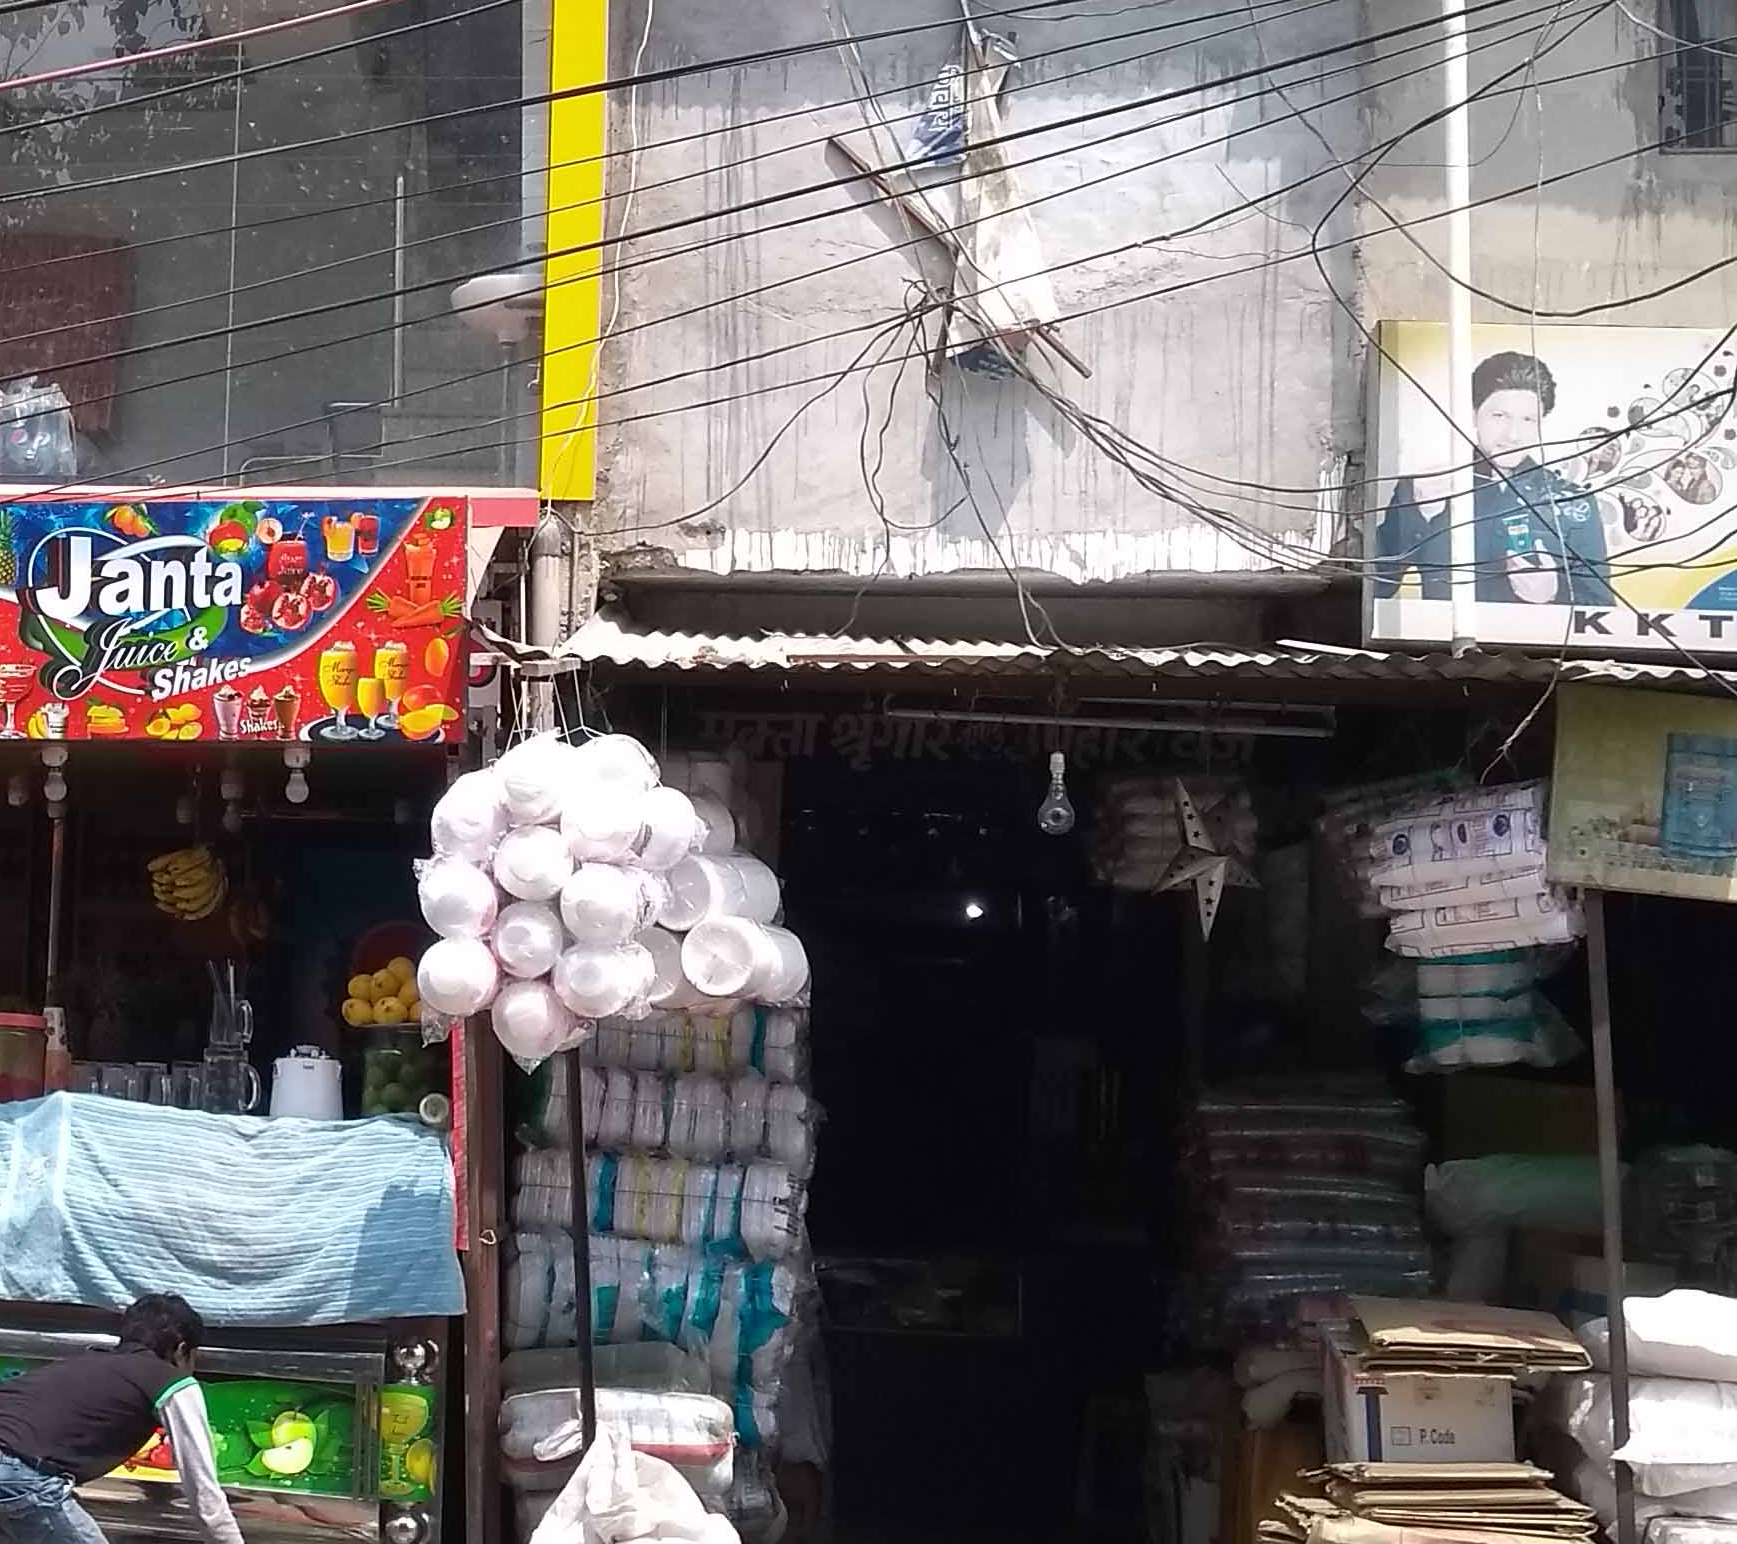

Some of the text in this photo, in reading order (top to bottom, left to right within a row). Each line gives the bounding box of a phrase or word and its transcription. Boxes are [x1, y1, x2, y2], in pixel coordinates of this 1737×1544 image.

[35, 535, 243, 619] Janta
[53, 617, 210, 701] Juice &
[151, 656, 253, 701] Shakes
